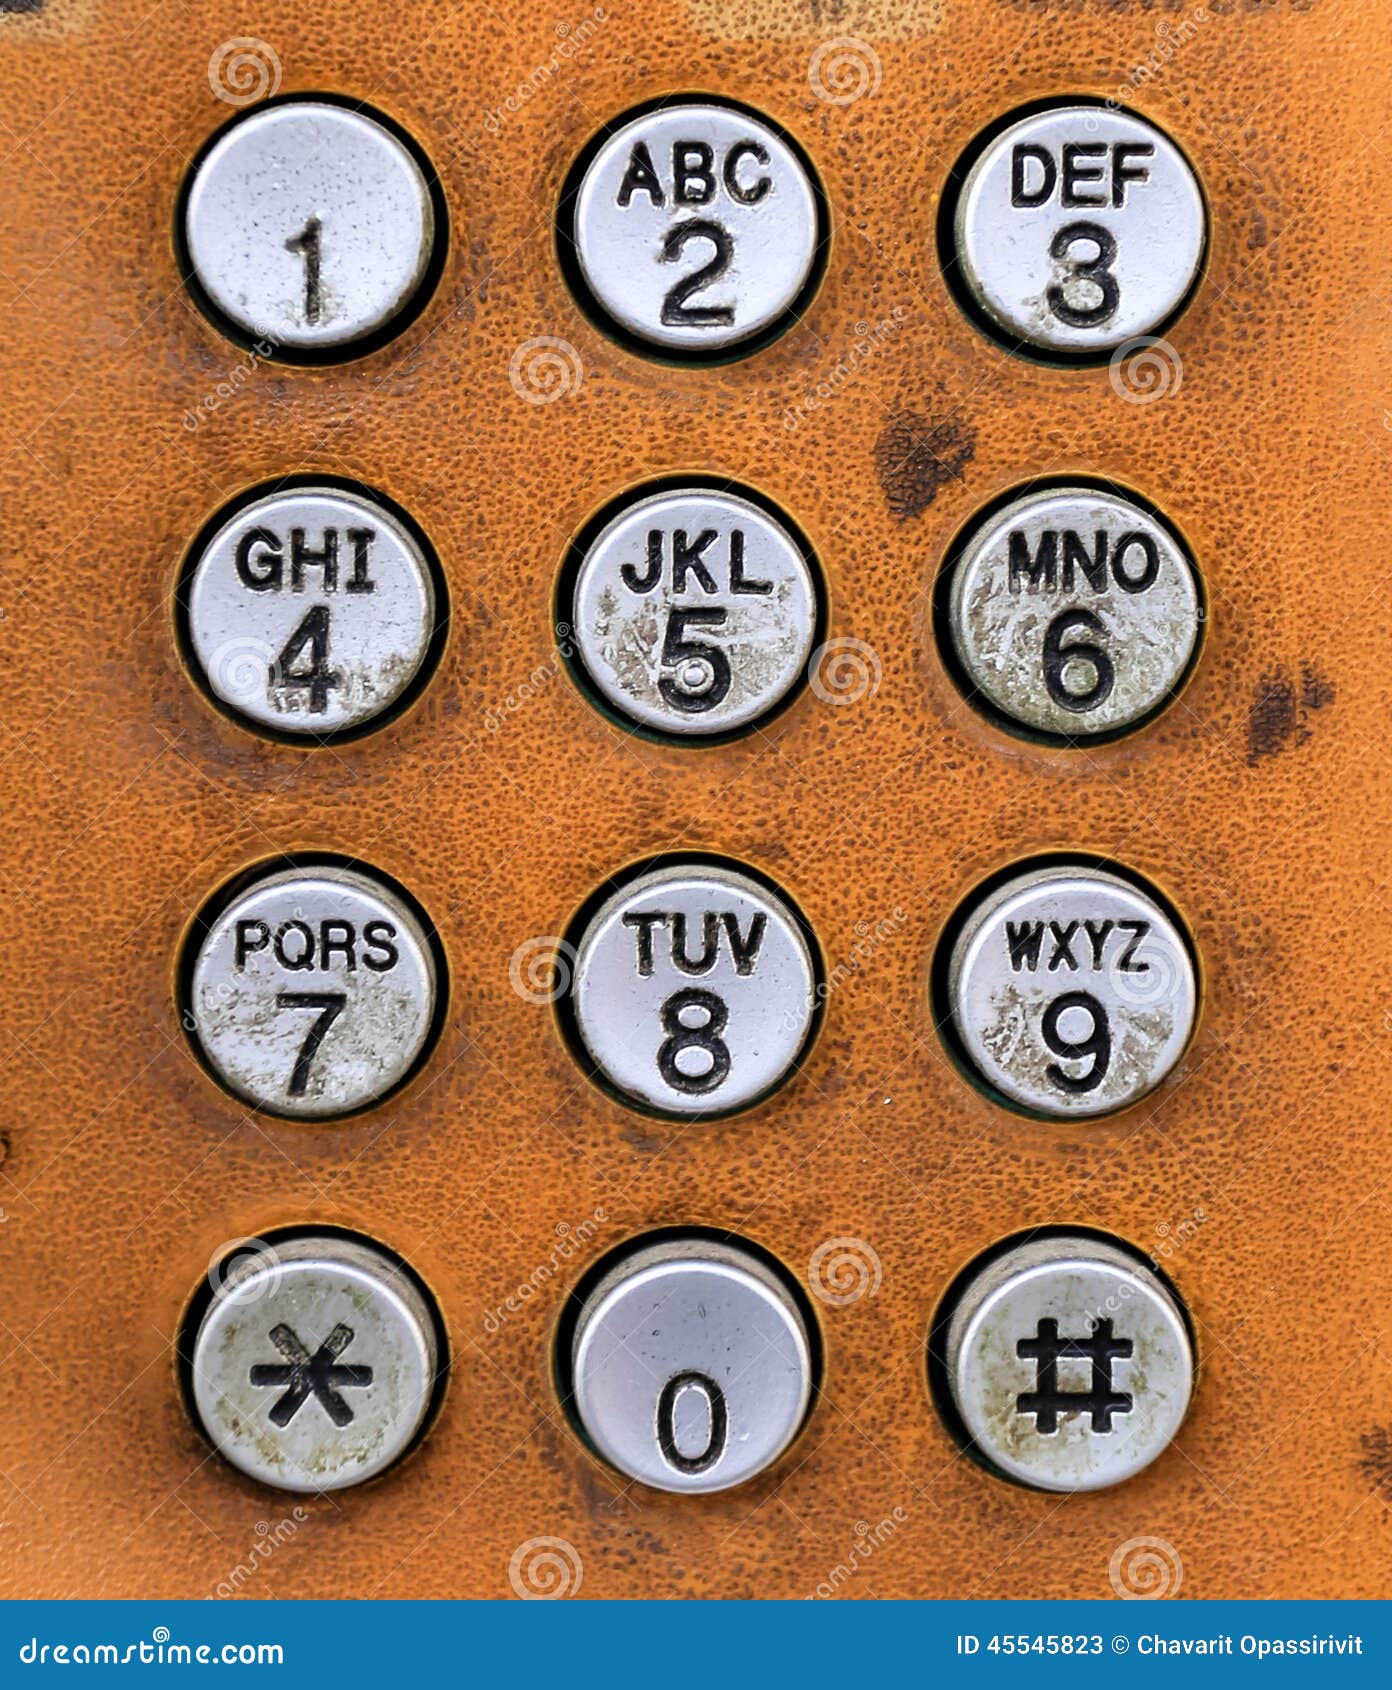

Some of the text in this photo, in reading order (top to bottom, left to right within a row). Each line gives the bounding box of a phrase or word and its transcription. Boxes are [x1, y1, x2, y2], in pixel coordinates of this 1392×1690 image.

[616, 140, 772, 207] ABC
[1009, 142, 1155, 209] DEF
[285, 215, 322, 326] 1
[658, 217, 735, 326] 2
[1046, 220, 1119, 328] 3
[234, 526, 377, 595] GHI
[619, 529, 775, 596] JKL
[1008, 530, 1161, 596] MNO
[268, 604, 341, 714] 4
[657, 605, 732, 714] 5
[1041, 606, 1116, 714] 6
[233, 919, 399, 973] PQRS
[621, 911, 768, 978] TUV
[1005, 919, 1150, 973] WXYZ
[276, 992, 348, 1098] 7
[656, 985, 732, 1096] 8
[1040, 989, 1112, 1095] 9
[656, 1368, 728, 1475] 0
